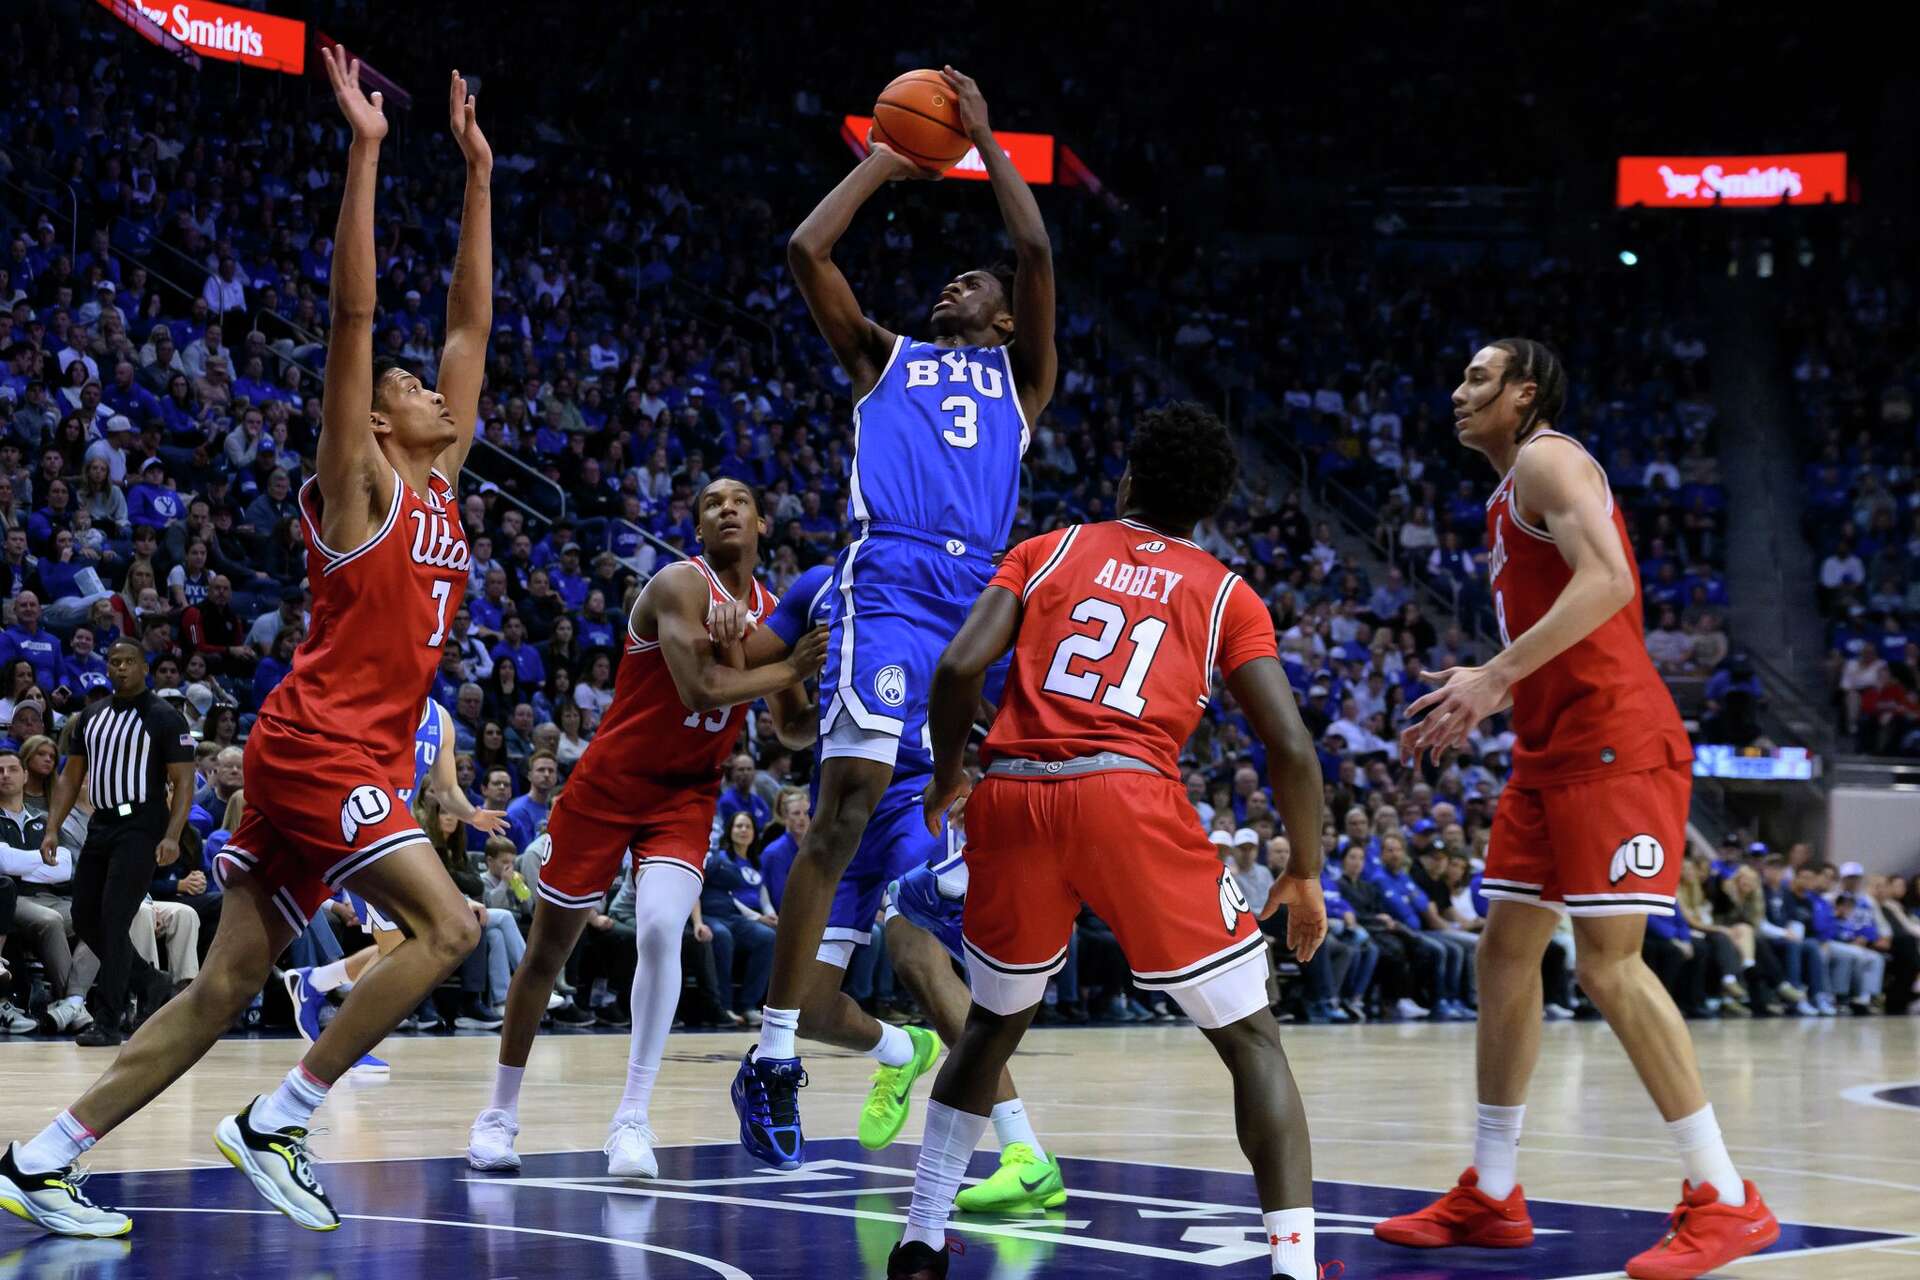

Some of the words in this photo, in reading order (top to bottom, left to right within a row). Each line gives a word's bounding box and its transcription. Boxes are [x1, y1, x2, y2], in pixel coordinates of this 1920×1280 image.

[171, 4, 264, 57] Smith's
[906, 350, 1004, 399] BYU
[940, 395, 979, 449] 3
[1094, 558, 1183, 604] ABBEY
[427, 579, 452, 647] 7
[1042, 597, 1168, 719] 21
[351, 789, 385, 820] U
[1632, 842, 1656, 870] U
